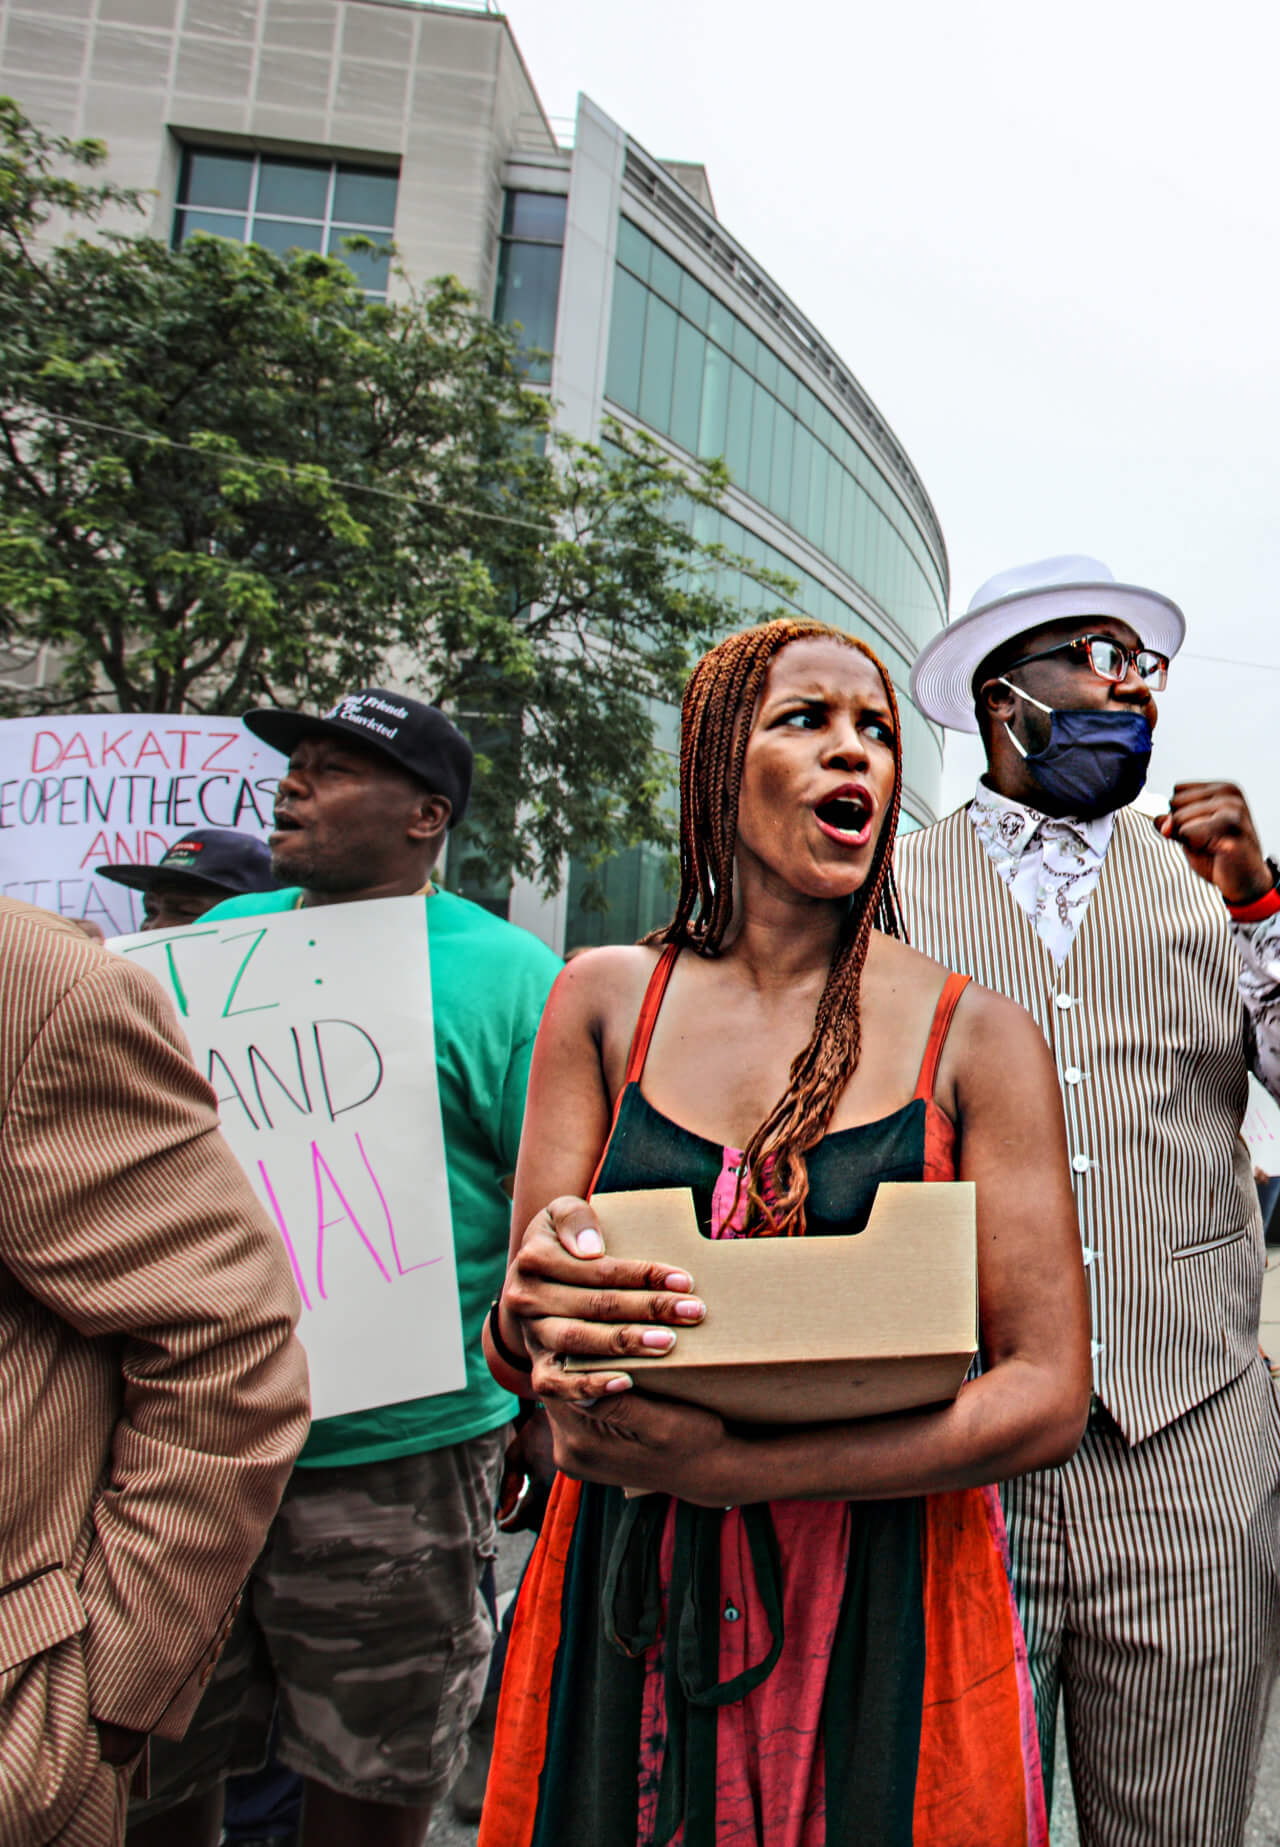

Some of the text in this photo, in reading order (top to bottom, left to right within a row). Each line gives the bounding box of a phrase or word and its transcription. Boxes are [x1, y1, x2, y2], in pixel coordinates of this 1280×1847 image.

[340, 711, 398, 739] Convicted
[80, 830, 169, 869] AND
[207, 1019, 384, 1131] AND
